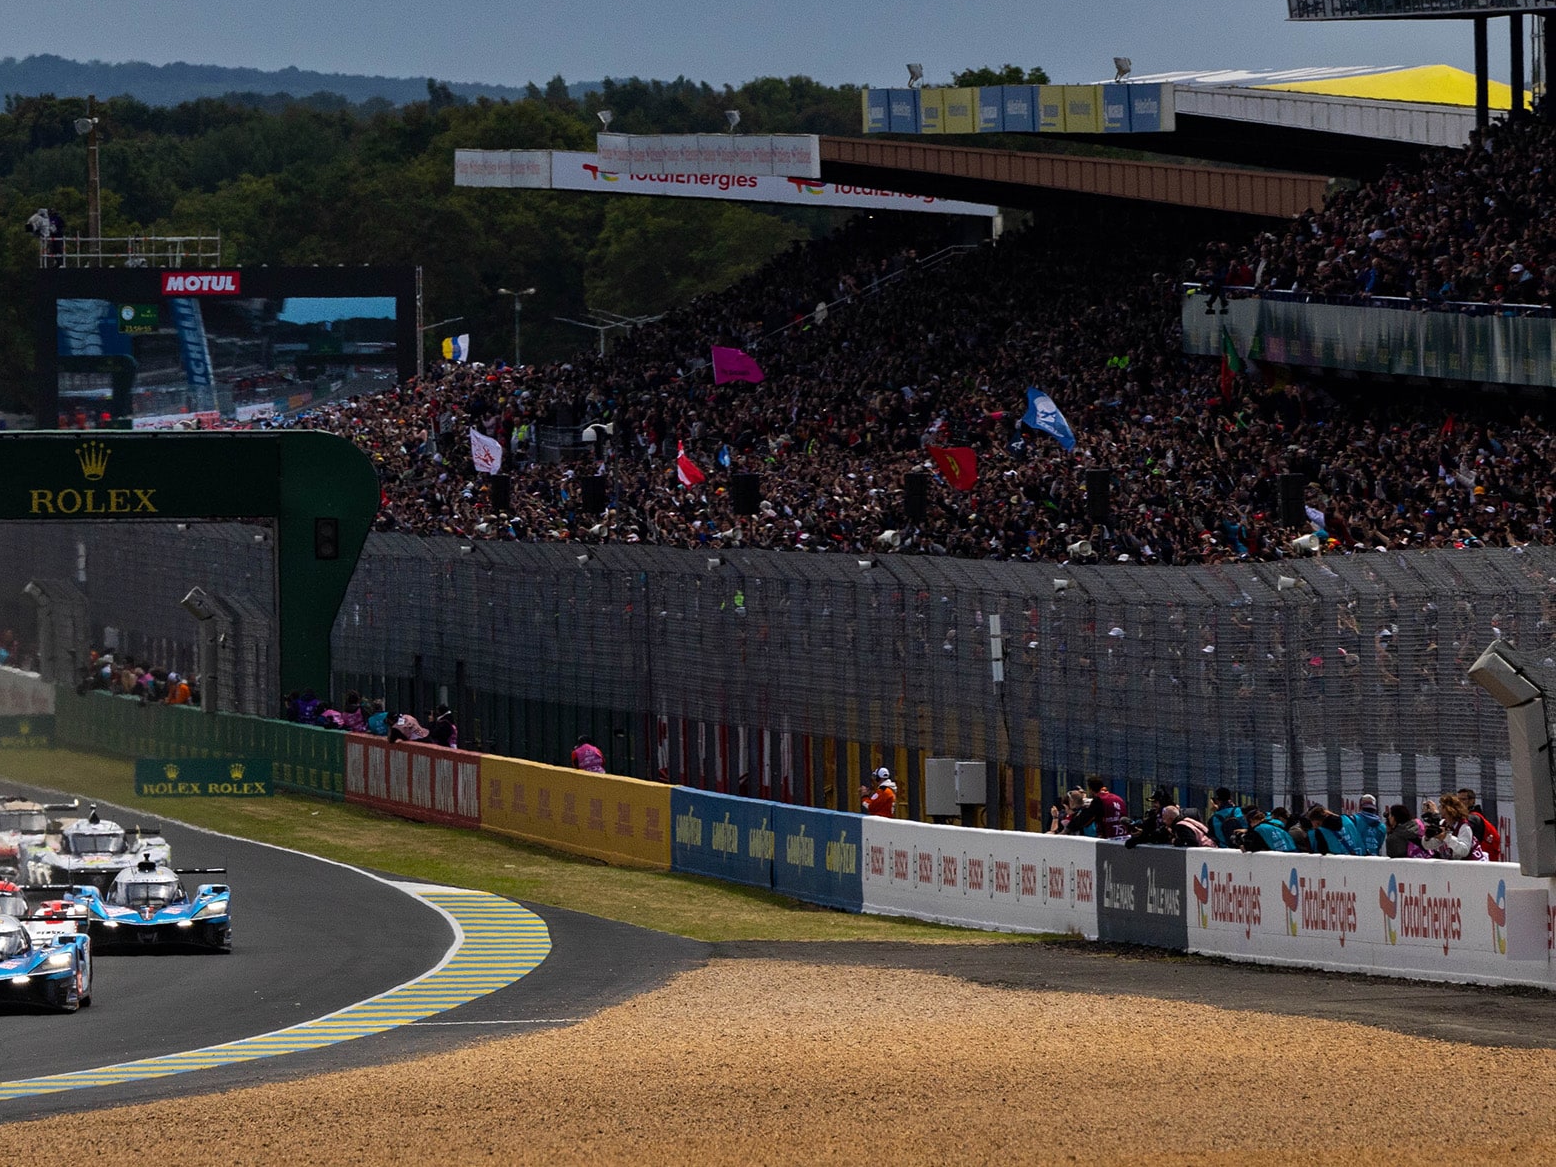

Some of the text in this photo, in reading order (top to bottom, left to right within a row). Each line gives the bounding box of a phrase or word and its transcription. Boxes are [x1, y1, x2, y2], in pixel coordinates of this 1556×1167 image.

[166, 276, 235, 291] MOTUL
[29, 489, 159, 514] ROLEX
[208, 781, 266, 794] ROLEX
[871, 845, 1092, 902] BOSCH BOSCH BOSCH BOSCH BOSCH BOSCH BOSCH BOSCH BOSCH
[1210, 871, 1261, 940] TotalEnergies
[1299, 876, 1358, 948] TotalEnergies
[1399, 881, 1462, 956] TotalEnergies
